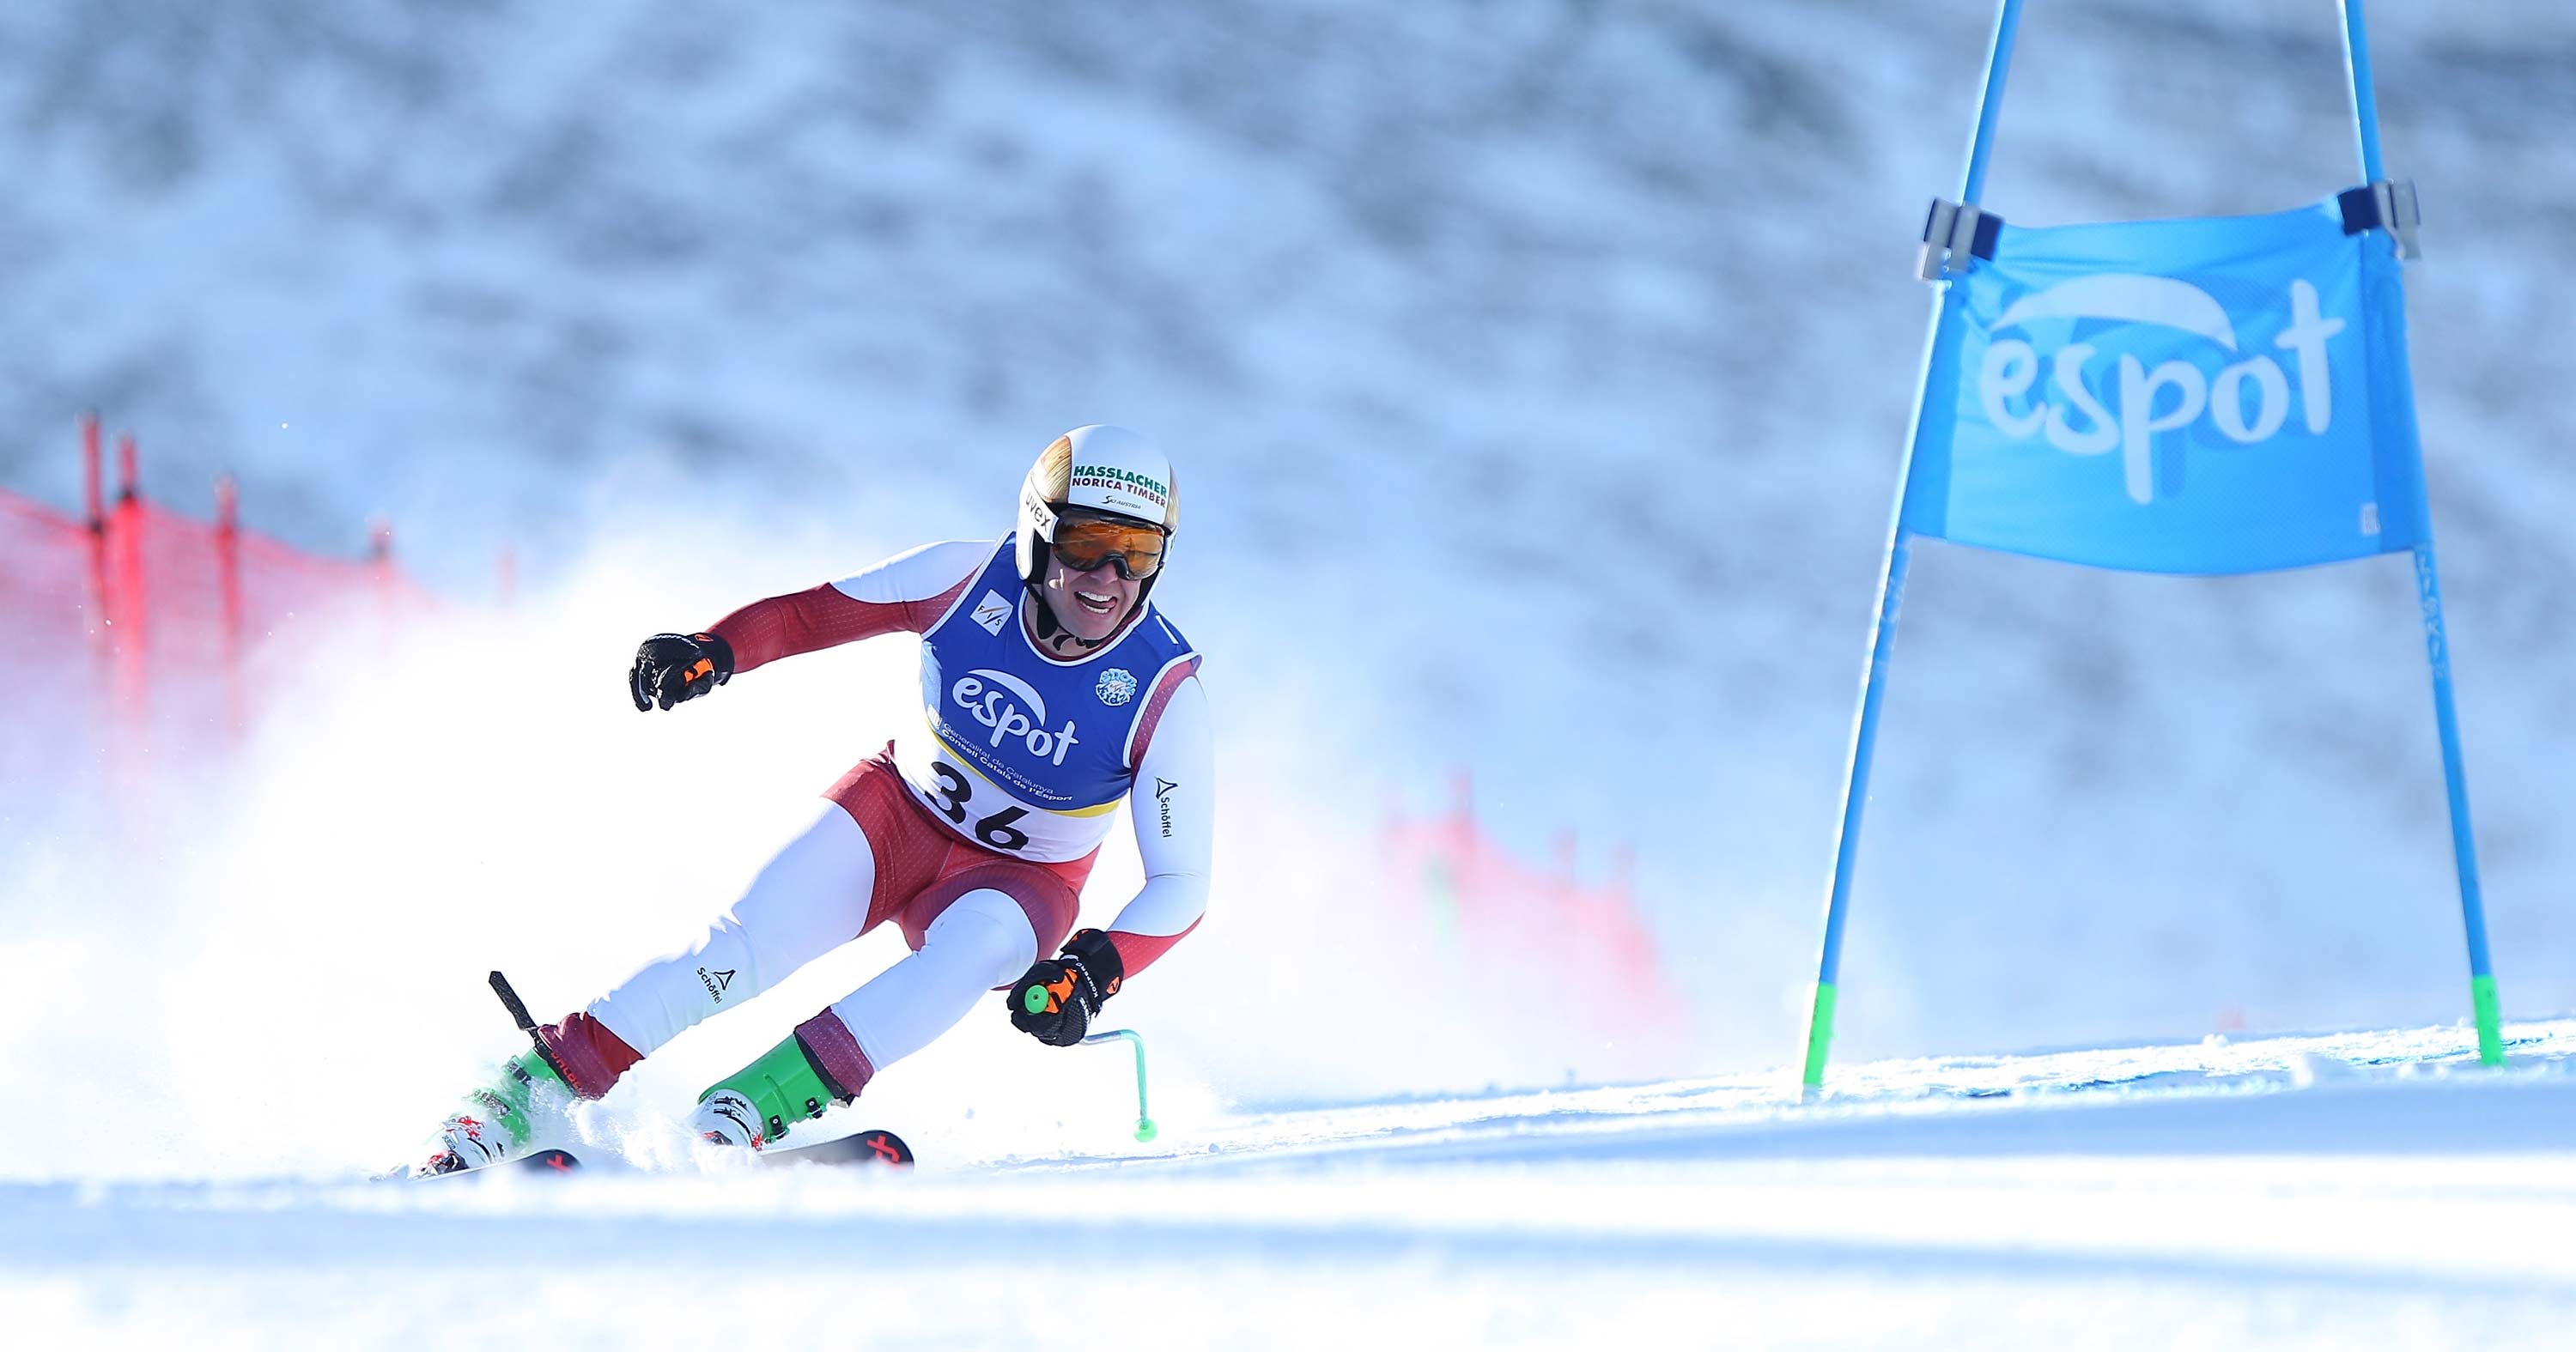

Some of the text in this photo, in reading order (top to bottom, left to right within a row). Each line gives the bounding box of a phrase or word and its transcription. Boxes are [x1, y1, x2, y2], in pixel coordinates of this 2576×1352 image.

[1980, 279, 2346, 504] espot
[1072, 477, 1166, 508] NORICA TIMBER
[1073, 465, 1167, 498] HASSLACHER
[1025, 492, 1051, 533] uvex
[952, 676, 1079, 767] espot
[942, 730, 978, 759] Consell
[1013, 779, 1027, 790] de
[944, 723, 1054, 794] Generalitat de Catalunya
[924, 761, 1030, 851] 36
[1161, 797, 1172, 838] Schöffel
[697, 967, 723, 1004] Schöffel
